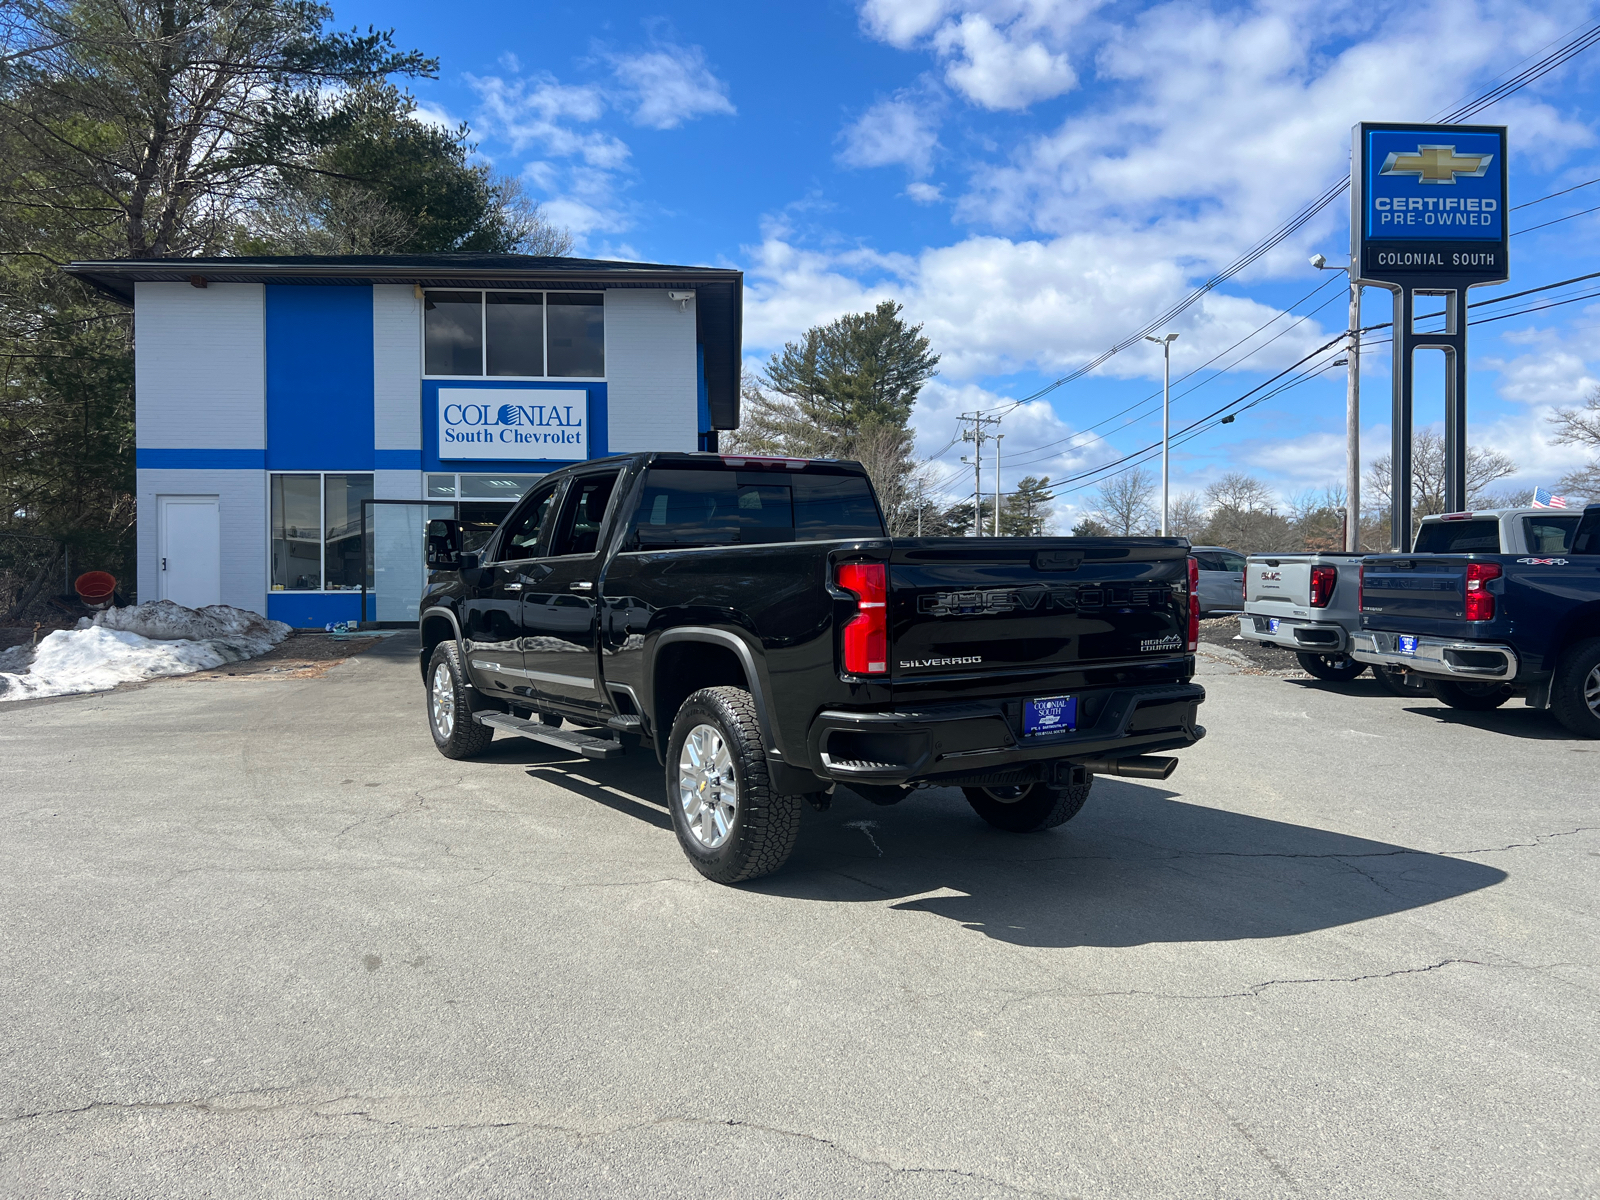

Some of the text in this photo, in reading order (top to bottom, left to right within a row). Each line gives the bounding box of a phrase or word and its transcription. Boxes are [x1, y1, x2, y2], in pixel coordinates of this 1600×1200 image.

[1375, 197, 1497, 212] CERTIFIED
[1381, 212, 1492, 226] PRE-OWNED
[1378, 252, 1495, 266] COLONIAL SOUTH
[443, 403, 582, 427] COLONIAL
[445, 427, 582, 444] South Chevrolet
[916, 586, 1172, 615] CHEVROLET
[1140, 644, 1182, 652] COUNTRY
[899, 655, 982, 668] SILVERADO
[1034, 701, 1066, 710] COLONIAL
[1038, 708, 1061, 716] SOUTH
